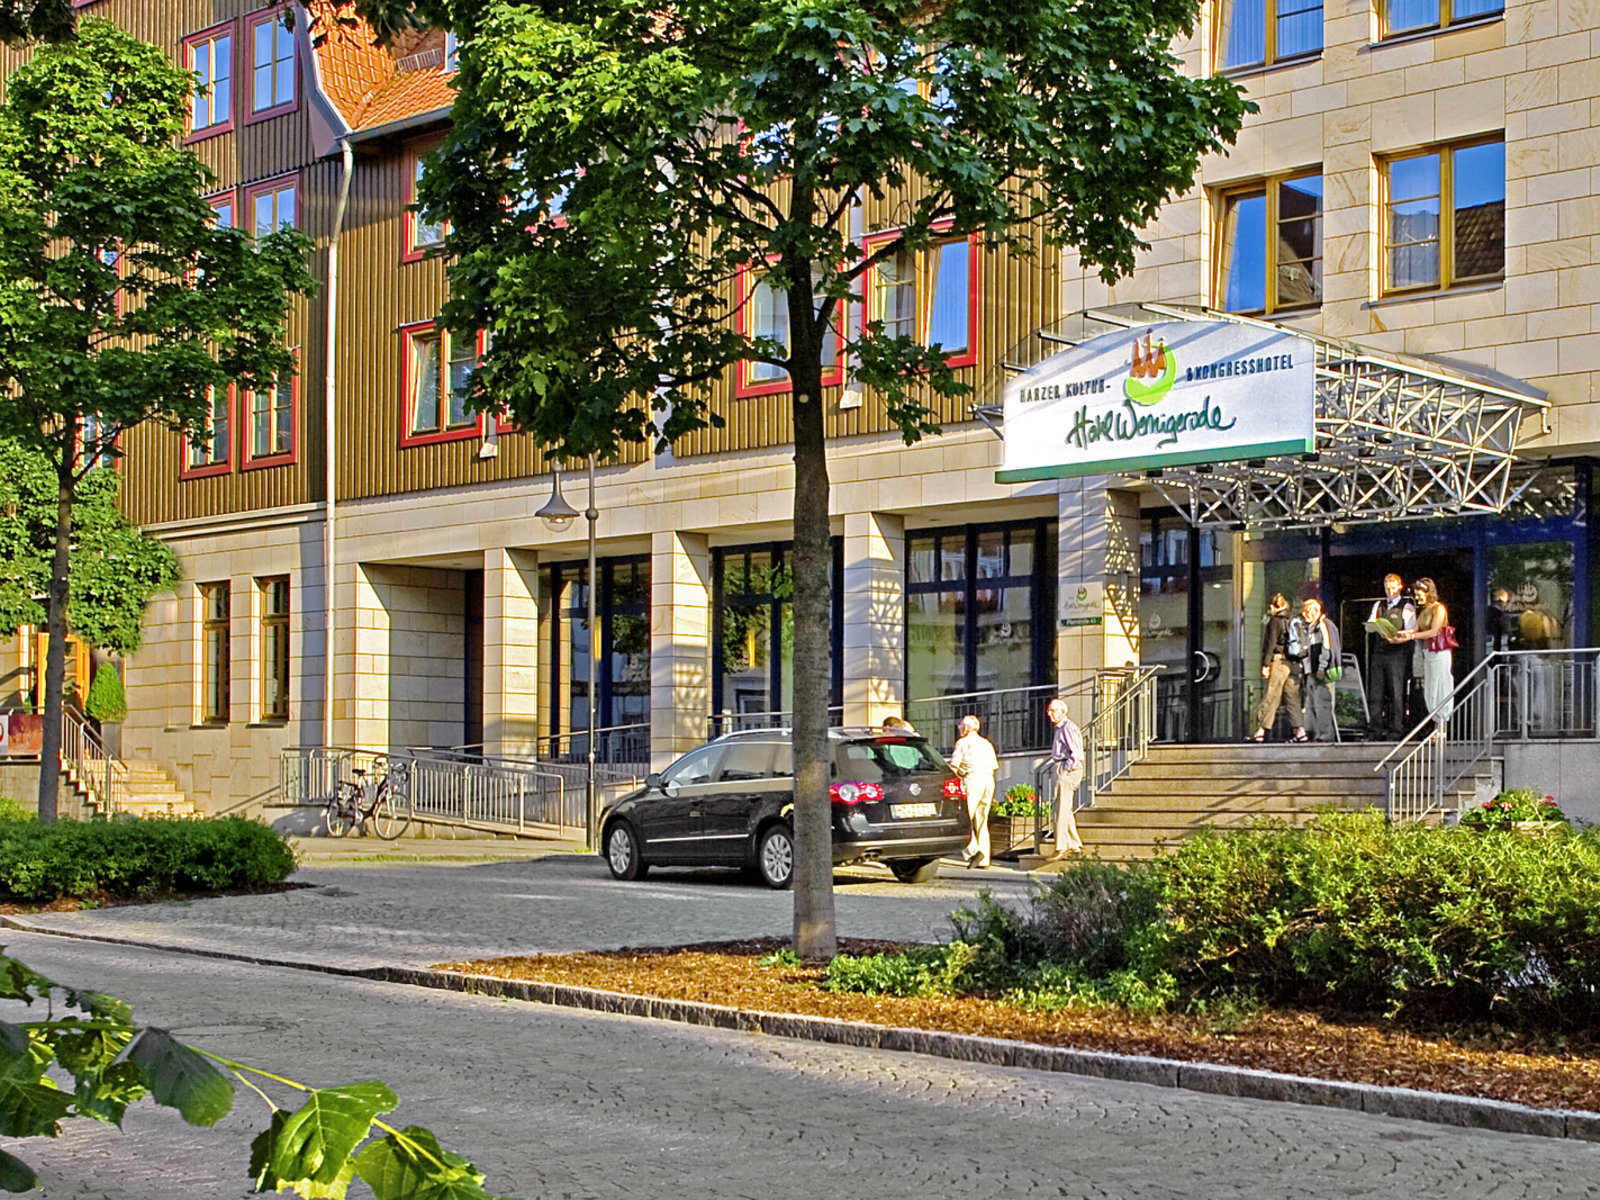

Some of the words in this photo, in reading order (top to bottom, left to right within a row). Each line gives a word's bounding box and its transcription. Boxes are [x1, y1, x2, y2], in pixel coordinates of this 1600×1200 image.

[1019, 385, 1060, 403] HARZER
[1065, 379, 1111, 398] KULTUR-
[1065, 405, 1113, 449] Hotel
[1116, 396, 1237, 449] Wernigerode
